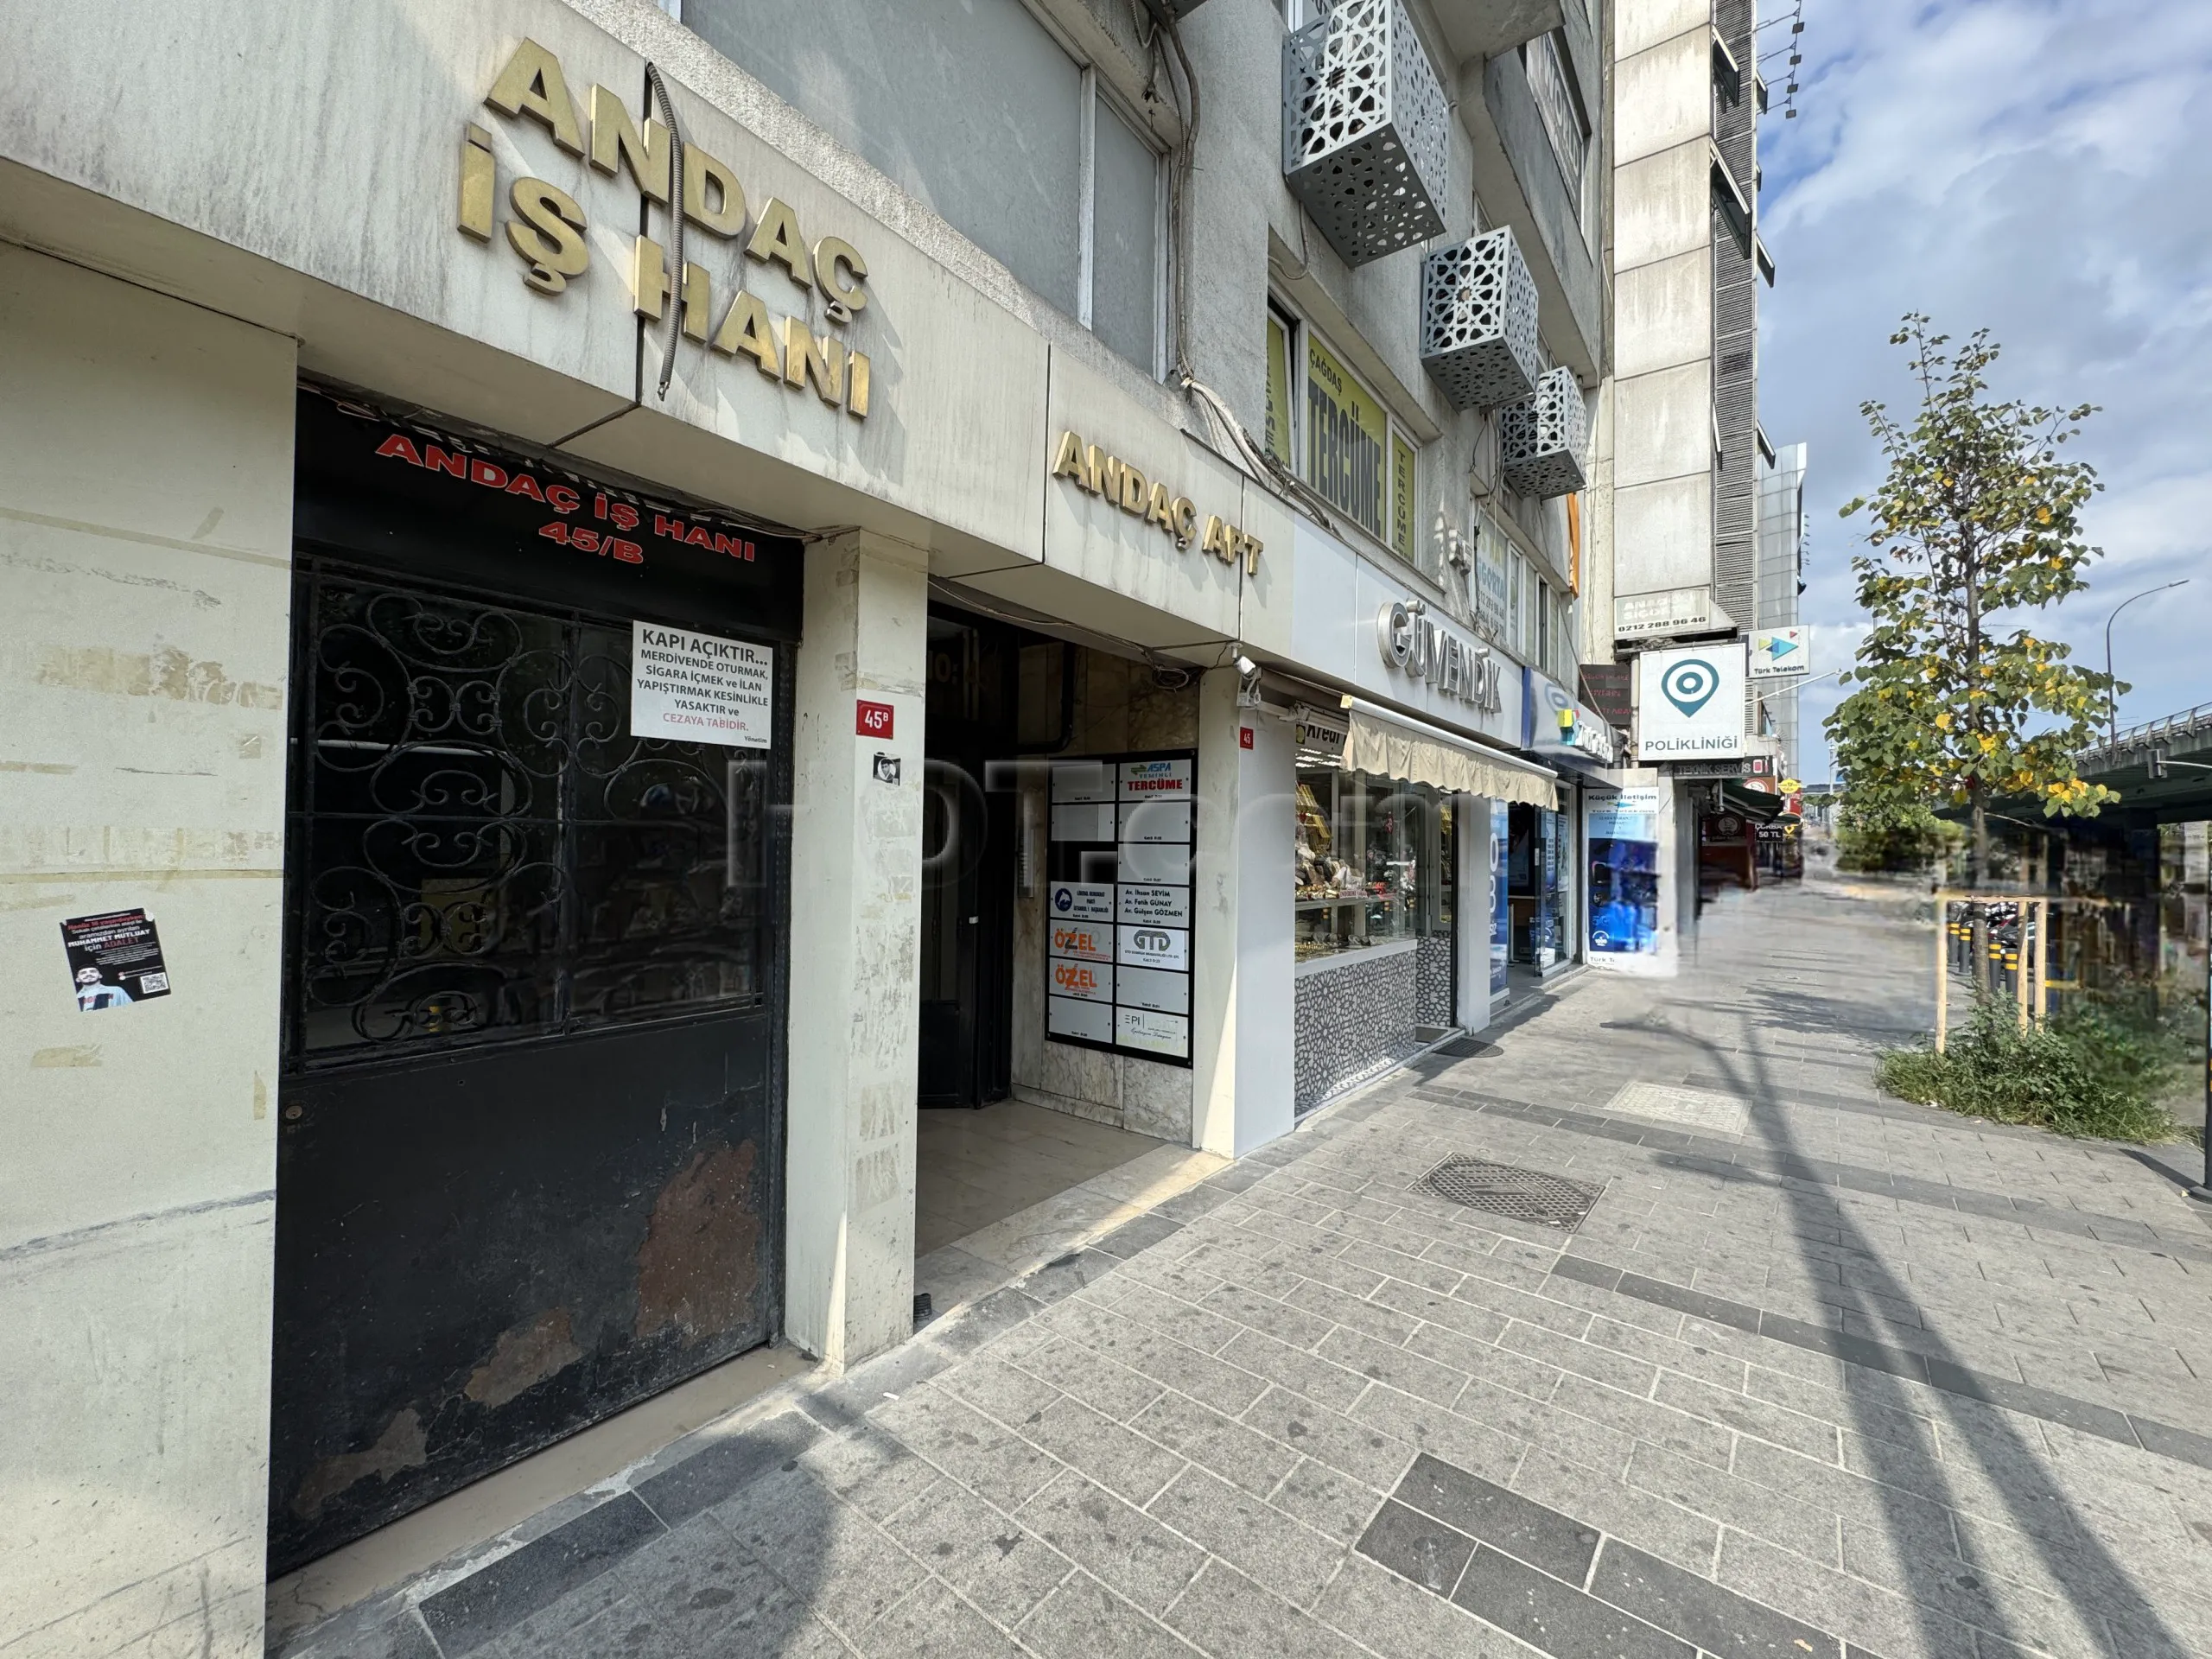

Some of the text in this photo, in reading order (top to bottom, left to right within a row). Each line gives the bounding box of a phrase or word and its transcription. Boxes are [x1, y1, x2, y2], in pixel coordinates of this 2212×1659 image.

[483, 36, 868, 325] ANDAÇ
[457, 122, 870, 419] İŞ HANI
[1309, 347, 1343, 396] ÇAĞDAŞ
[1308, 376, 1381, 538] TERCÜME
[375, 432, 755, 562] ANDAÇ İŞ HANI
[1052, 430, 1263, 576] ANDAÇ APT
[538, 521, 645, 564] 45/B
[1618, 624, 1645, 632] 0212
[642, 628, 768, 666] KAPI AÇIKTIR...
[1377, 599, 1502, 714] GÜVENDİK
[641, 649, 768, 680] MERDİVENDE OTURMAK,
[1754, 664, 1805, 676] Türk Telekom
[645, 664, 762, 692] SİGARA İÇMEK ve İLAN
[637, 678, 768, 707] YAPIŞTIRMAK KESİNLİKLE
[675, 699, 726, 715] YASAKTIR
[663, 713, 749, 732] CEZAYA TABİDİR.
[744, 735, 767, 744] Yönetim
[1644, 735, 1738, 752] POLİKLİNİĞİ
[1147, 762, 1172, 772] ASPA
[1678, 762, 1751, 775] TEKNİK SERVİS
[1128, 779, 1183, 791] TERCÜME
[1150, 899, 1173, 907] GÜNAY
[1154, 908, 1183, 917] GÖZMEN
[67, 929, 150, 947] MUHAMMET MUTLUAY
[84, 937, 139, 952] için ADALET
